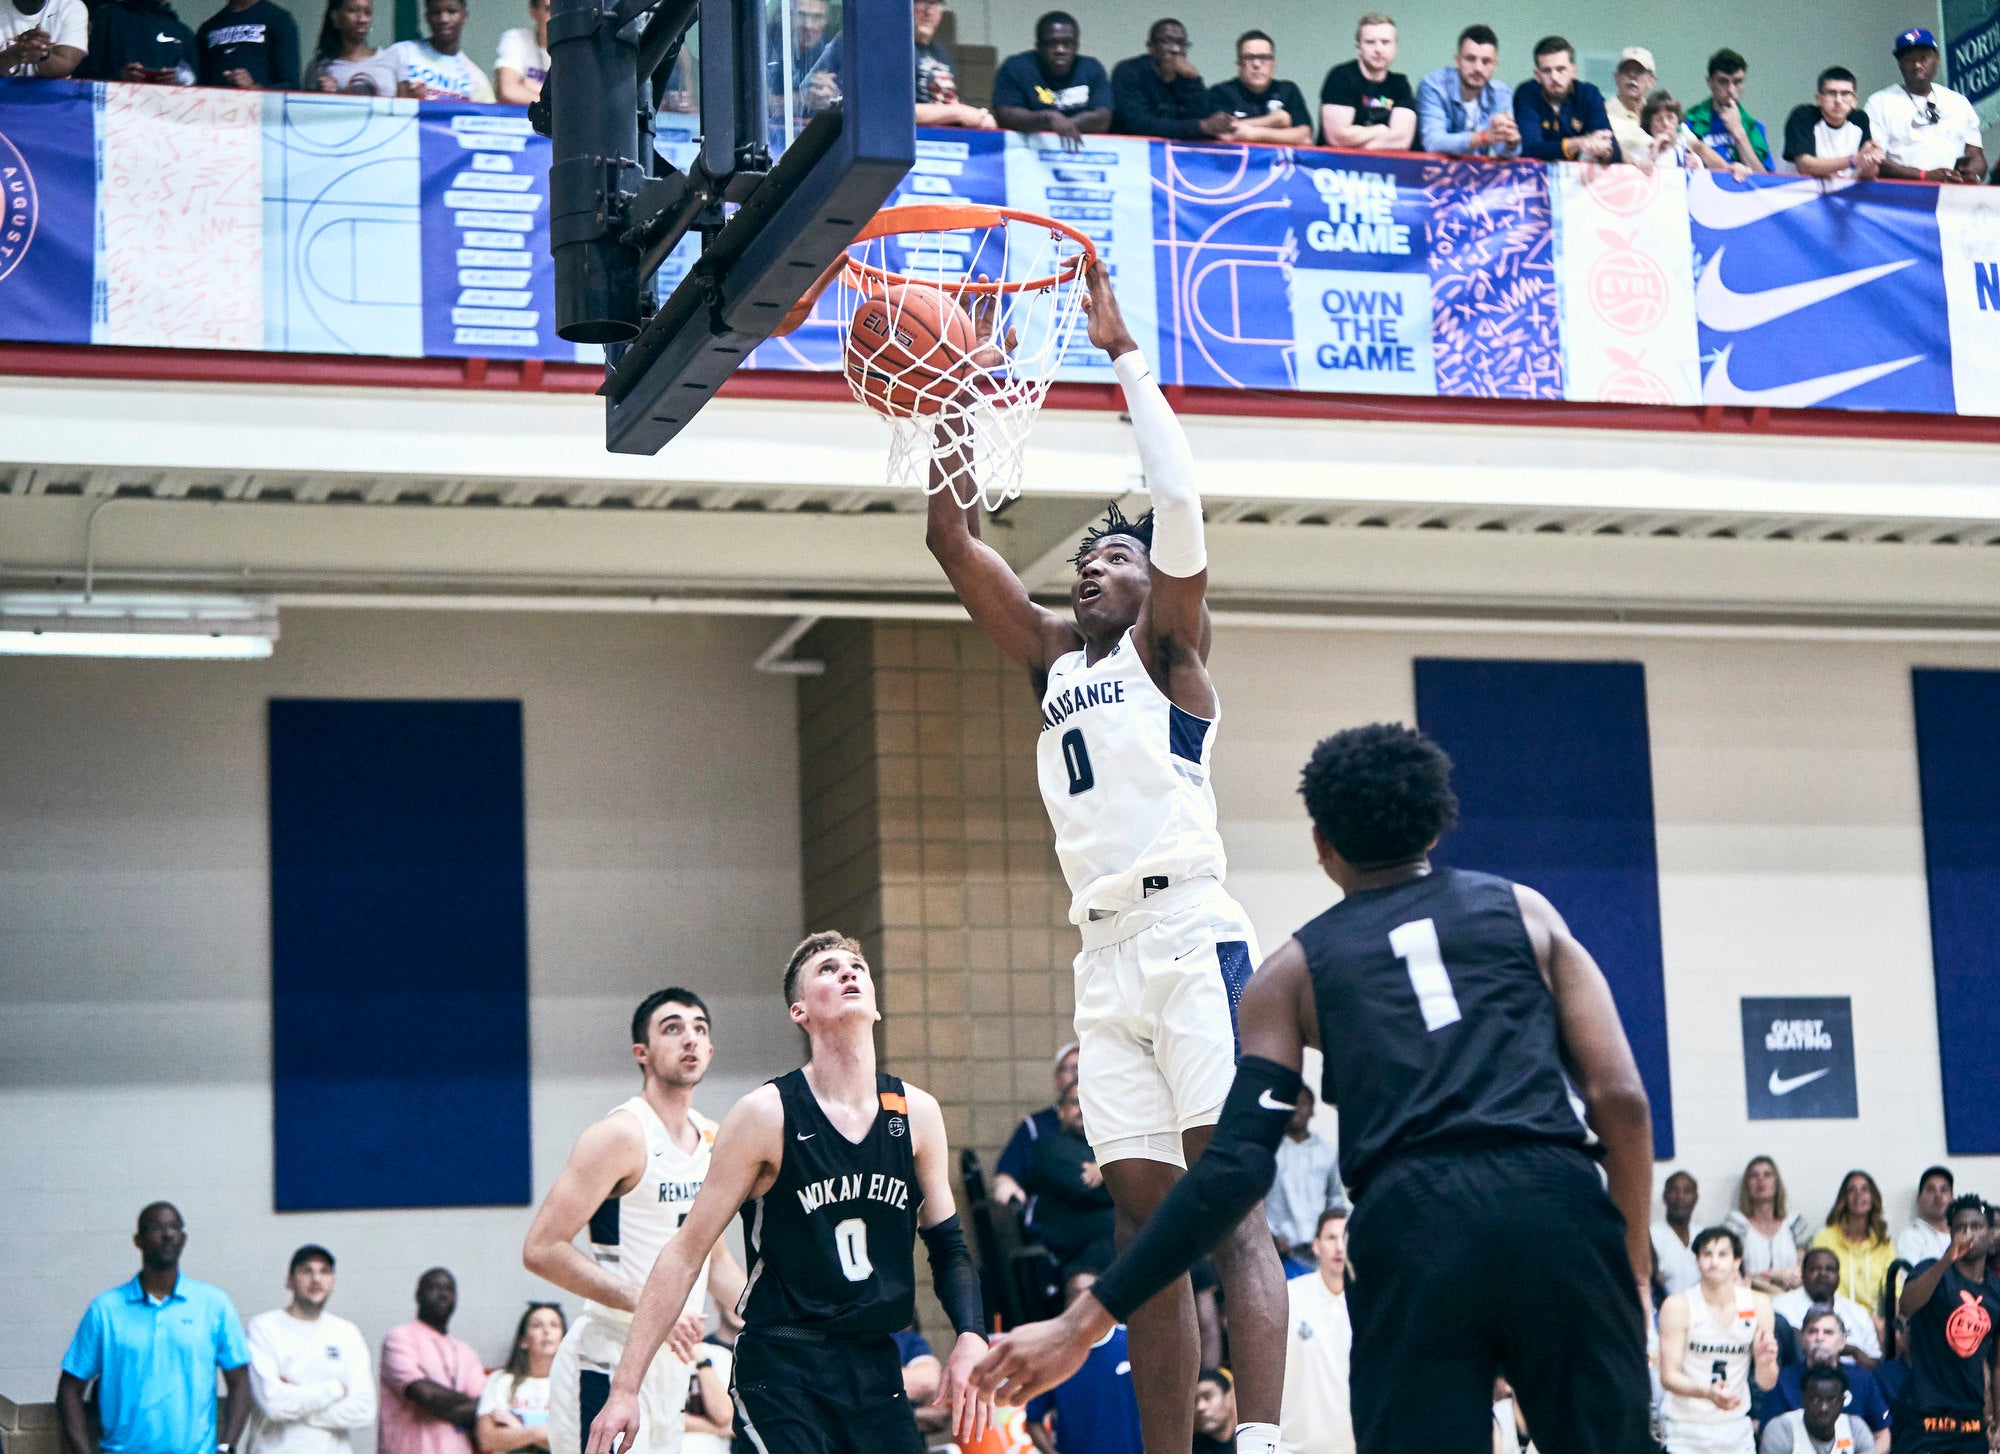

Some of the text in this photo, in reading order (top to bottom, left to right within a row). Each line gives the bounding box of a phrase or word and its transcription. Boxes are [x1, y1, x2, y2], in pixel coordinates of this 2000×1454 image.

[1312, 168, 1398, 200] OWN
[0, 166, 28, 266] AUGUST
[1322, 195, 1394, 224] THE
[1306, 220, 1411, 255] GAME
[1601, 275, 1658, 297] EYBL
[1321, 289, 1403, 316] OWN
[1330, 317, 1399, 343] THE
[1316, 343, 1416, 373] GAME
[1062, 726, 1095, 797] 0
[1152, 878, 1159, 886] L
[1388, 918, 1462, 1032] 1
[1765, 1032, 1832, 1051] SEATING
[1771, 1019, 1824, 1037] GUEST
[797, 1174, 909, 1214] MOKAN ELITE
[835, 1218, 873, 1282] 0
